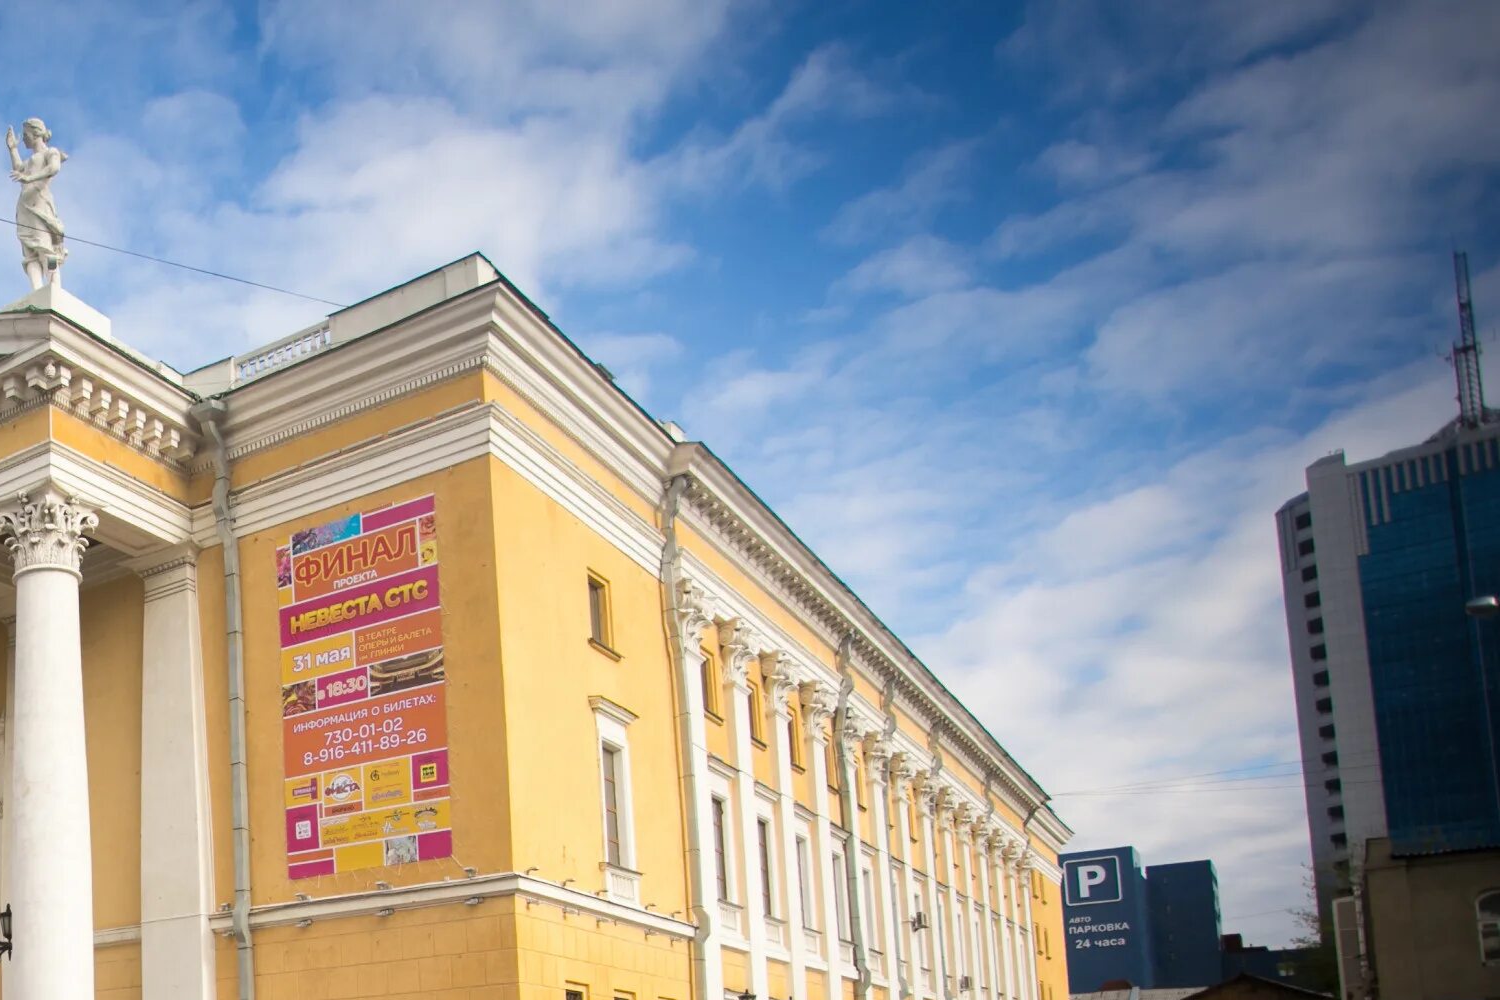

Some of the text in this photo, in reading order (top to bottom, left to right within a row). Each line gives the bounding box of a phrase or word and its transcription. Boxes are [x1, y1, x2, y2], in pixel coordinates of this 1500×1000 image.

[294, 524, 417, 587] ФИНАЛ
[333, 570, 378, 590] ПРОЕКТА
[290, 579, 429, 635] НЕВЕСТА СТС
[358, 626, 398, 643] В ТЕАТРЕ
[358, 627, 433, 652] ОПЕРЫ И БАЛЕТА
[292, 646, 351, 672] 31 мая
[370, 643, 404, 659] ГЛИНКИ
[326, 675, 367, 698] 18:30
[293, 693, 437, 733] ИНФОРМАЦИЯ О БИЛЕТАХ:
[324, 717, 404, 745] 730-01-02
[303, 728, 427, 766] 8-916-411-89-26
[1077, 865, 1106, 898] P
[1069, 916, 1091, 924] АВТО
[1069, 922, 1130, 935] ПАРКОВКА
[1075, 938, 1125, 949] 24 часа
